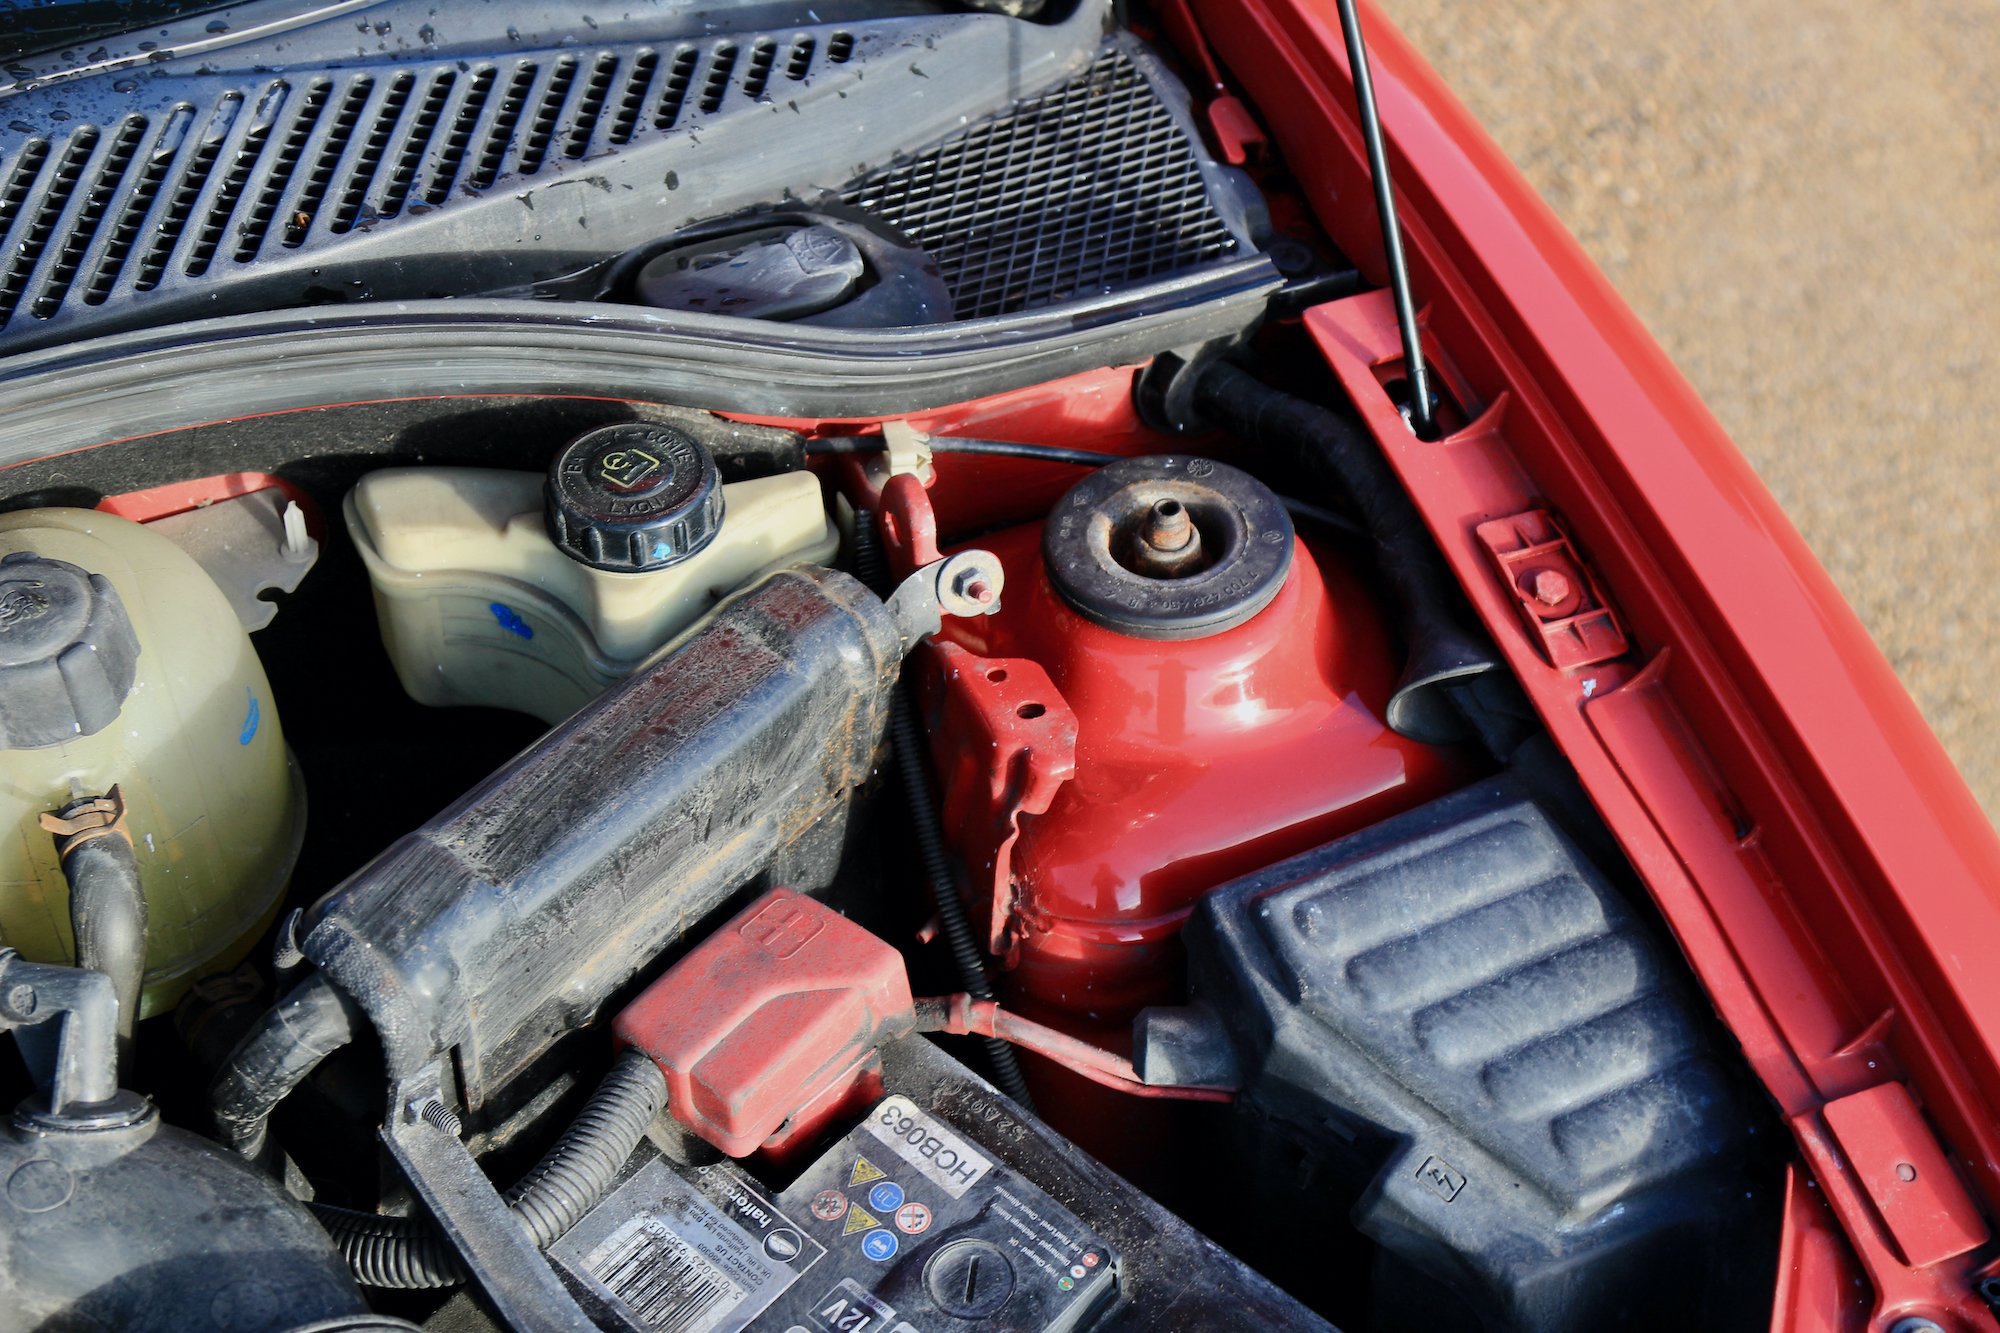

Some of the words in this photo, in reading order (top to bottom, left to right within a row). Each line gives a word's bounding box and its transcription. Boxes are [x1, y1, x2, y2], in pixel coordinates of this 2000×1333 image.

[609, 500, 665, 516] LYON
[878, 1104, 978, 1185] HCB063
[993, 1183, 1022, 1207] Alternator
[707, 1214, 719, 1225] for
[989, 1202, 1012, 1221] Battery
[1018, 1203, 1038, 1220] Check
[1009, 1216, 1037, 1240] Recharge
[1038, 1219, 1057, 1234] Level
[715, 1231, 743, 1256] Halfords
[717, 1222, 750, 1250] Produced
[1007, 1236, 1019, 1247] OK
[1054, 1230, 1071, 1245] Fluid
[713, 1243, 728, 1256] US
[1020, 1245, 1046, 1267] Charged
[1037, 1238, 1071, 1266] Discharged
[1068, 1241, 1083, 1254] Low
[744, 1255, 757, 1266] IRL
[689, 1254, 731, 1290] 015025
[720, 1261, 742, 1281] Code:
[725, 1253, 764, 1286] CONTACT
[760, 1268, 772, 1279] UK
[1043, 1262, 1059, 1278] Fully
[739, 1277, 757, 1294] Item
[732, 1290, 742, 1300] 5
[820, 1297, 871, 1333] 12V
